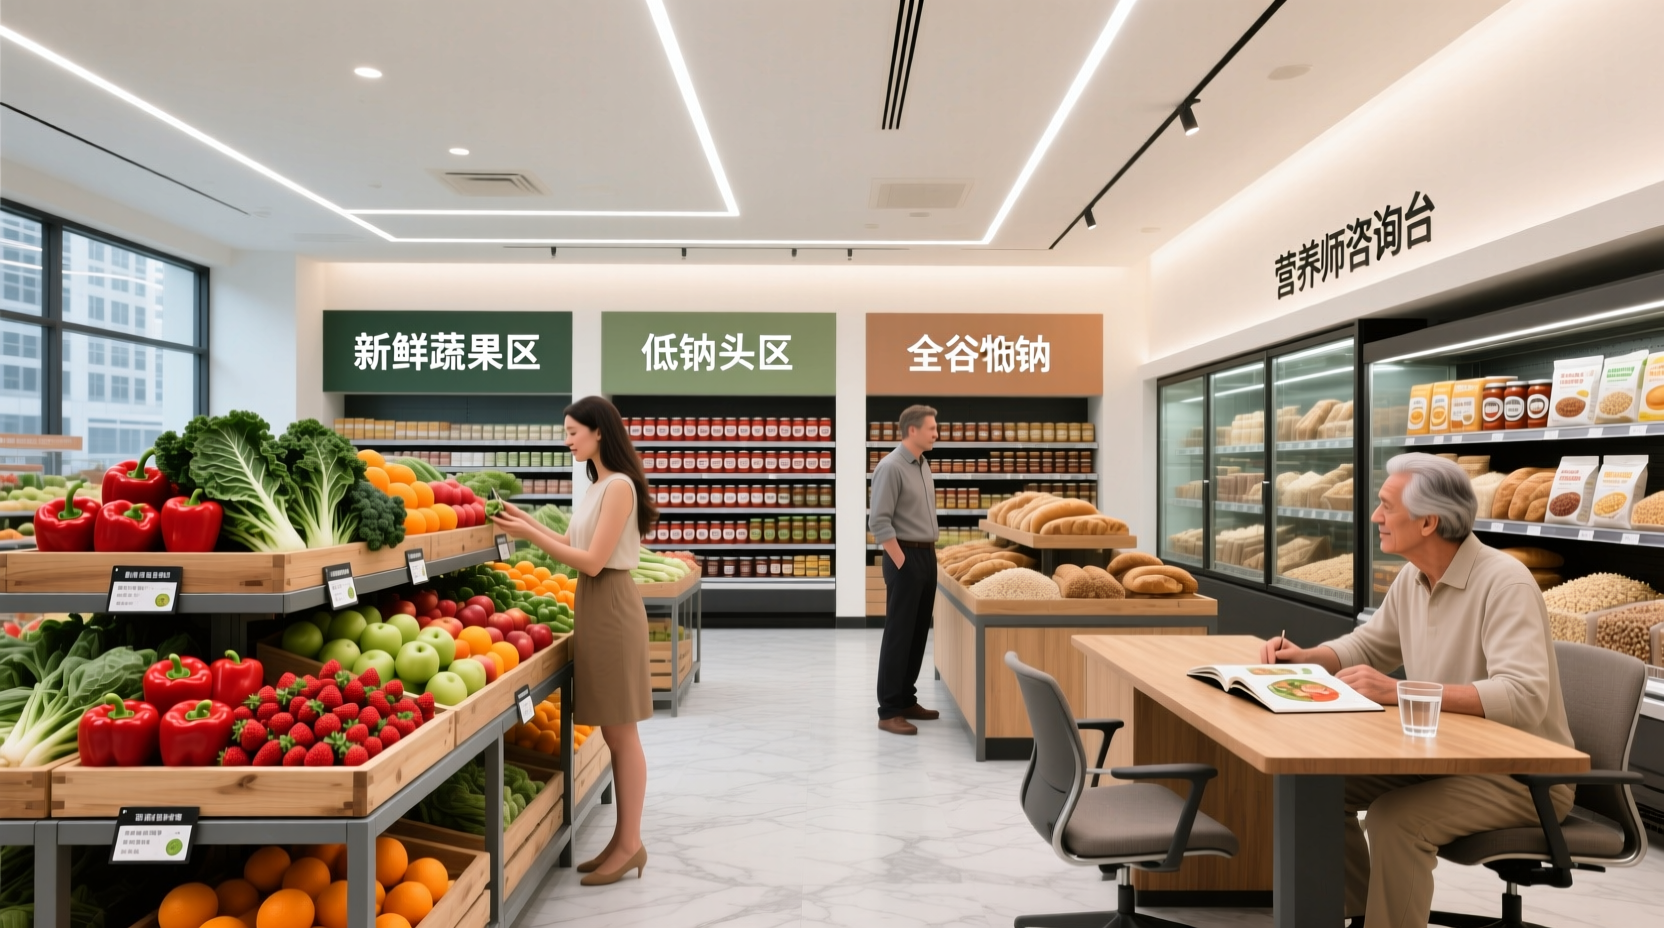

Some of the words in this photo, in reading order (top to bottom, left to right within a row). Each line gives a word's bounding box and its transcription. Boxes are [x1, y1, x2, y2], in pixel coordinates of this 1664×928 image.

[1275, 191, 1435, 300] 营养师咨询台
[354, 332, 540, 371] 新鲜蔬果区
[641, 333, 793, 371] 低钠头区
